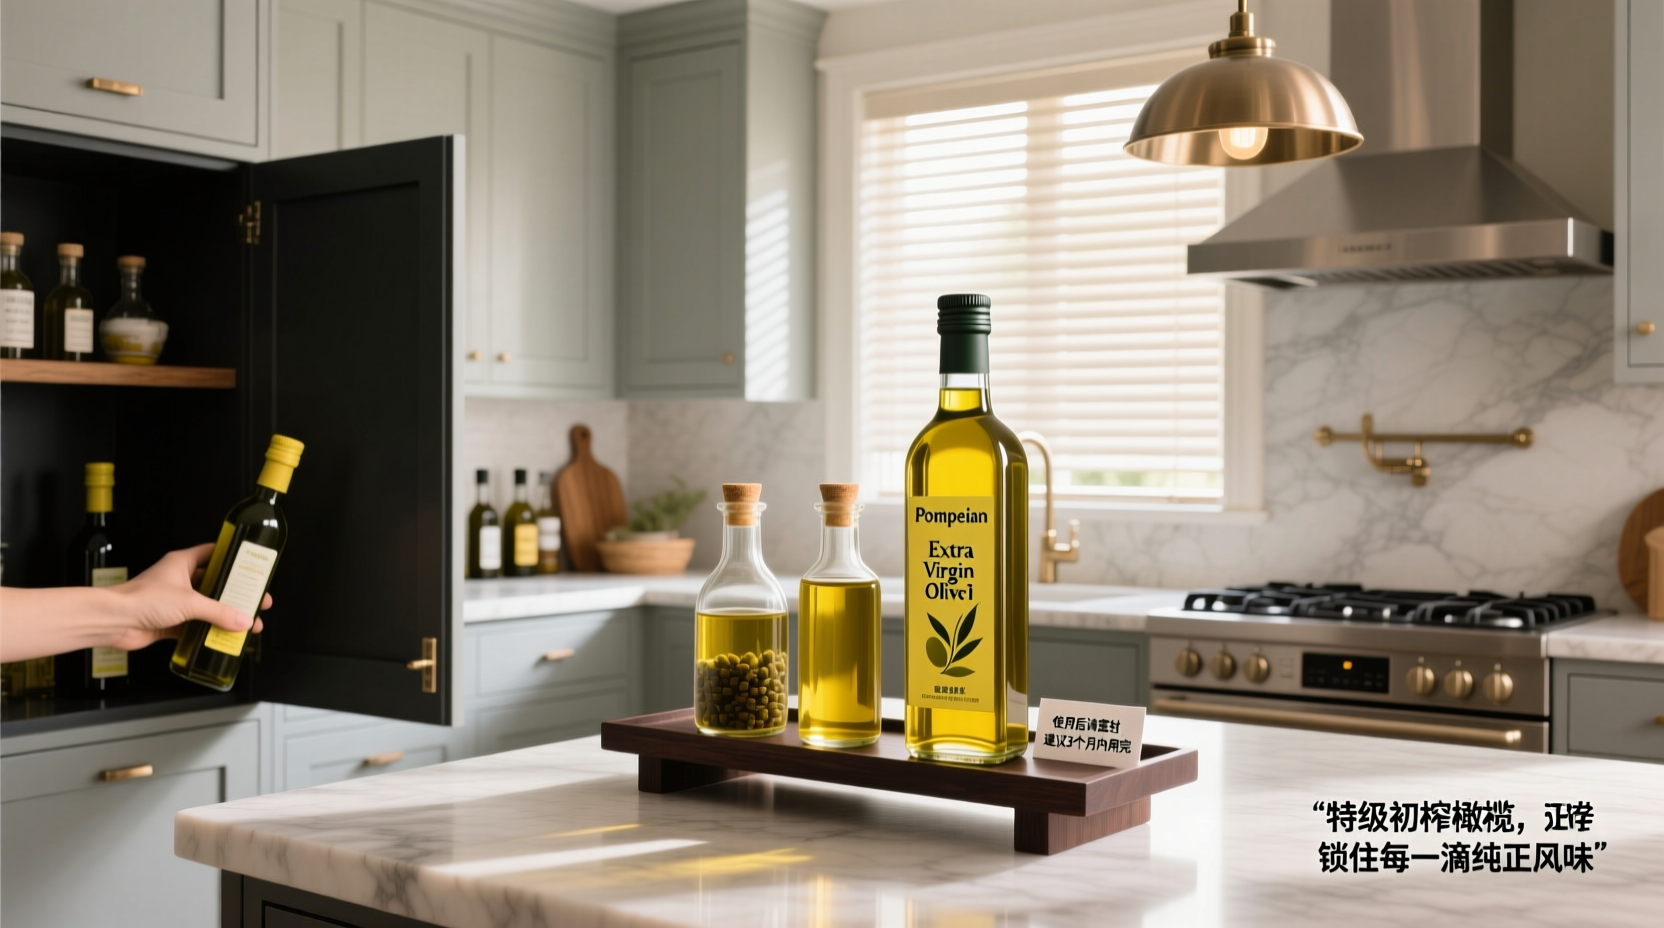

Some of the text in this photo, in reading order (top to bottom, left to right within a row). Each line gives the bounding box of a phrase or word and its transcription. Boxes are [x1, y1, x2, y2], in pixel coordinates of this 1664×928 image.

[915, 507, 988, 528] Pompeian
[928, 540, 974, 559] Extra
[923, 561, 974, 585] Virgin
